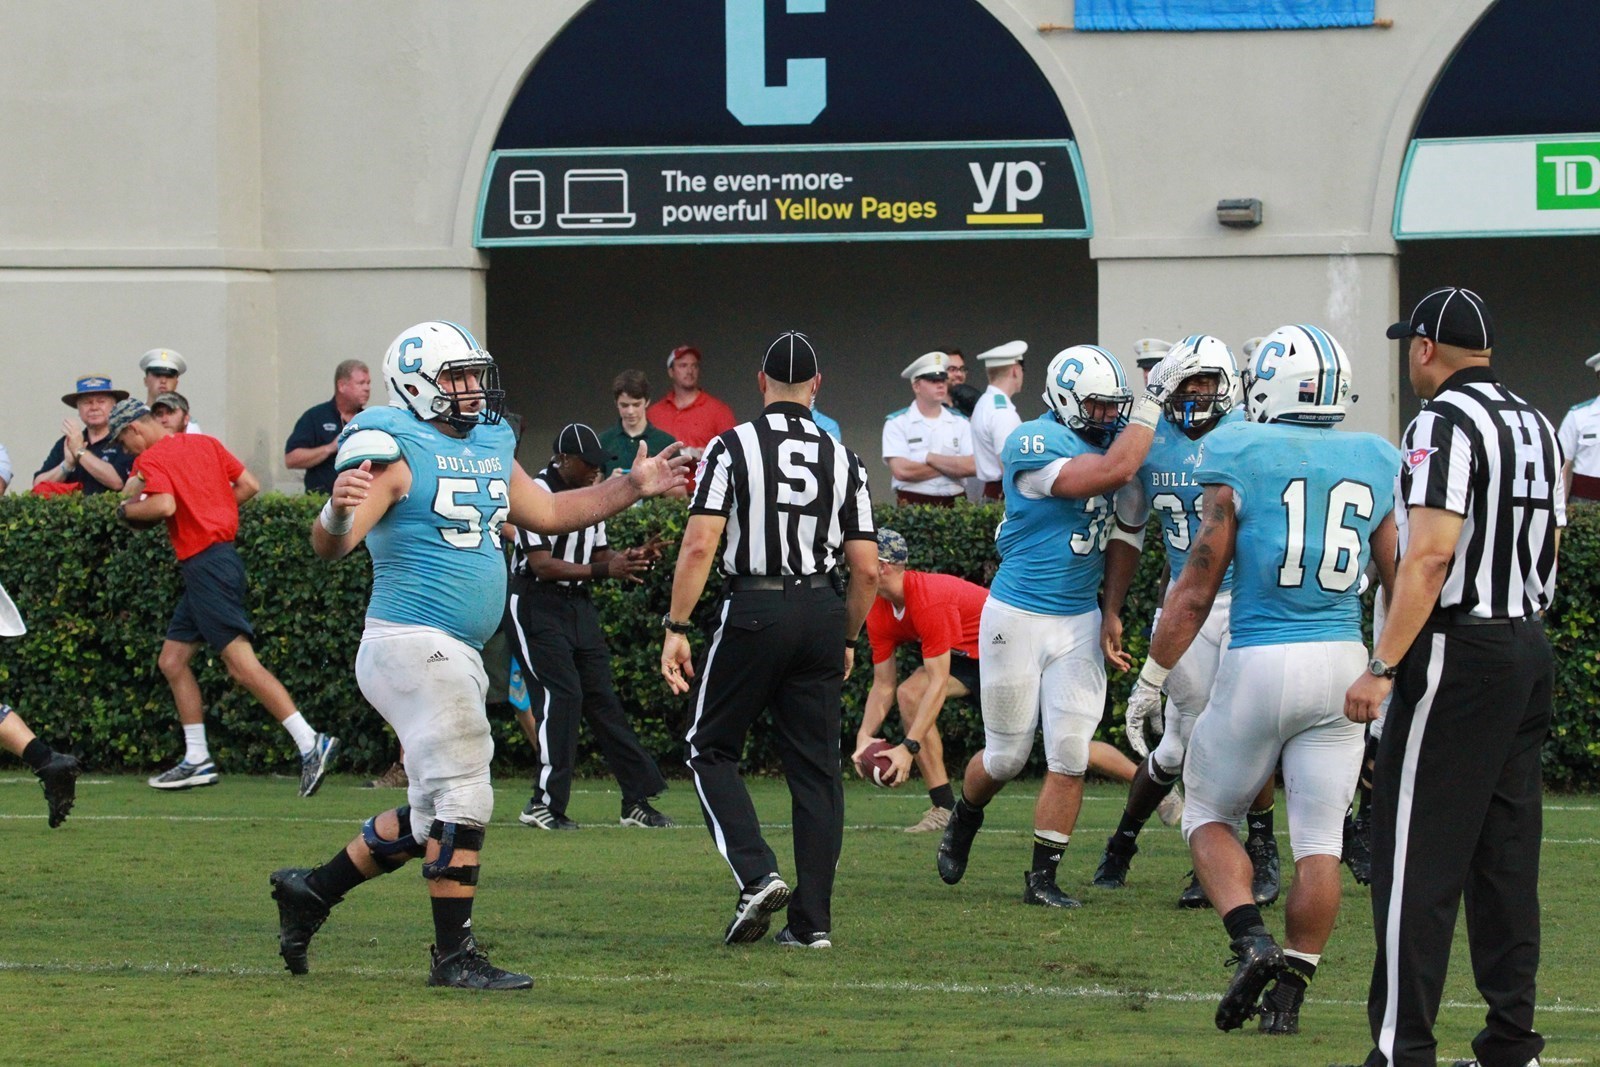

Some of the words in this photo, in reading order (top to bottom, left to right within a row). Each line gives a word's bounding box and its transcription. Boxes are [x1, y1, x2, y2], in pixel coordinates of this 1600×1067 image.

[661, 170, 706, 192] The
[713, 172, 853, 192] even-more-
[968, 160, 1043, 213] yp
[1543, 154, 1600, 196] TD
[662, 198, 768, 227] powerful
[775, 197, 853, 221] Yellow
[861, 196, 938, 223] Pages
[398, 336, 423, 374] C
[1056, 357, 1084, 390] C
[1256, 341, 1286, 380] C
[1019, 434, 1045, 454] 36
[1498, 409, 1549, 499] H
[435, 454, 502, 474] BULLDOGS
[777, 438, 819, 507] S
[431, 476, 510, 550] 52
[1277, 477, 1375, 593] 16
